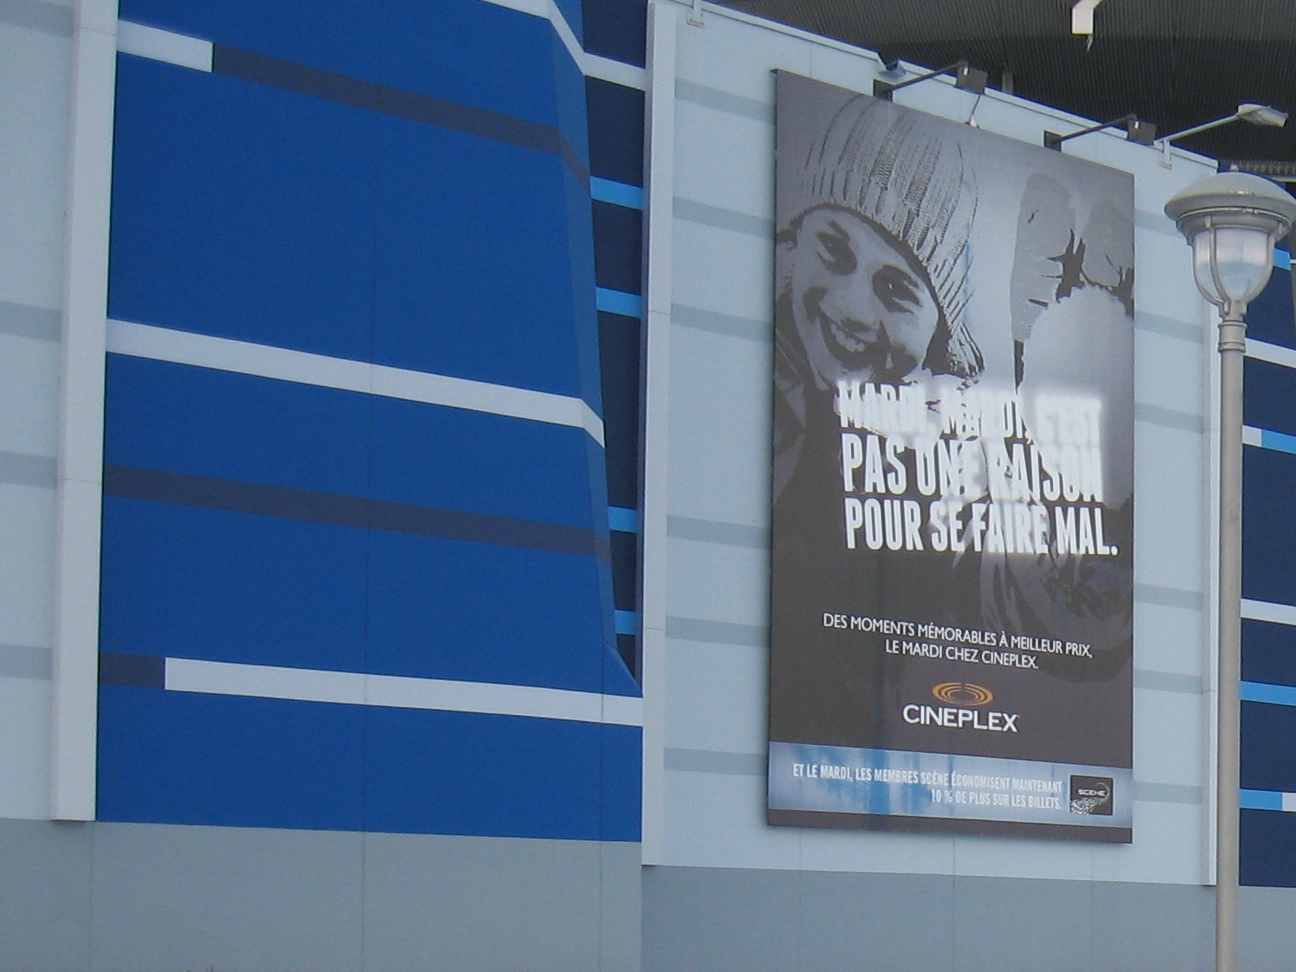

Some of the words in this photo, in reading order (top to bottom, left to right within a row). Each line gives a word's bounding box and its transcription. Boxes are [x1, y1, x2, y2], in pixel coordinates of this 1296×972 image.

[841, 432, 907, 495] PAS
[914, 434, 981, 499] UNE
[988, 440, 1103, 502] RAISON
[844, 497, 924, 551] POUR
[929, 499, 965, 552] SE
[971, 501, 1049, 554] FAIRE
[1055, 506, 1119, 556] MAL.
[823, 612, 848, 630] DES
[850, 616, 915, 637] MOMENTS
[917, 621, 997, 646] MÉMORABLES
[998, 630, 1009, 648] À
[1011, 635, 1063, 654] MEILLEUR
[1065, 642, 1093, 659] PRIX,
[885, 639, 900, 655] LE
[902, 642, 943, 659] MARDI
[945, 646, 979, 663] CHEZ
[981, 650, 1039, 670] CINEPLEX.
[902, 703, 1019, 733] CINEPLEX
[793, 763, 805, 777] ET
[806, 765, 818, 778] LE
[820, 765, 853, 782] MARDI,
[855, 767, 872, 782] LES
[874, 768, 919, 784] MEMBRES
[920, 769, 949, 786] SCÈNE
[951, 770, 1010, 790] ÉCONOMISENT
[1012, 779, 1063, 793] MAINTENANT
[931, 789, 942, 803] 10
[944, 790, 953, 803] %
[955, 791, 967, 804] DE
[969, 792, 990, 805] PLUS
[992, 793, 1010, 806] SUR
[1011, 795, 1026, 808] LES
